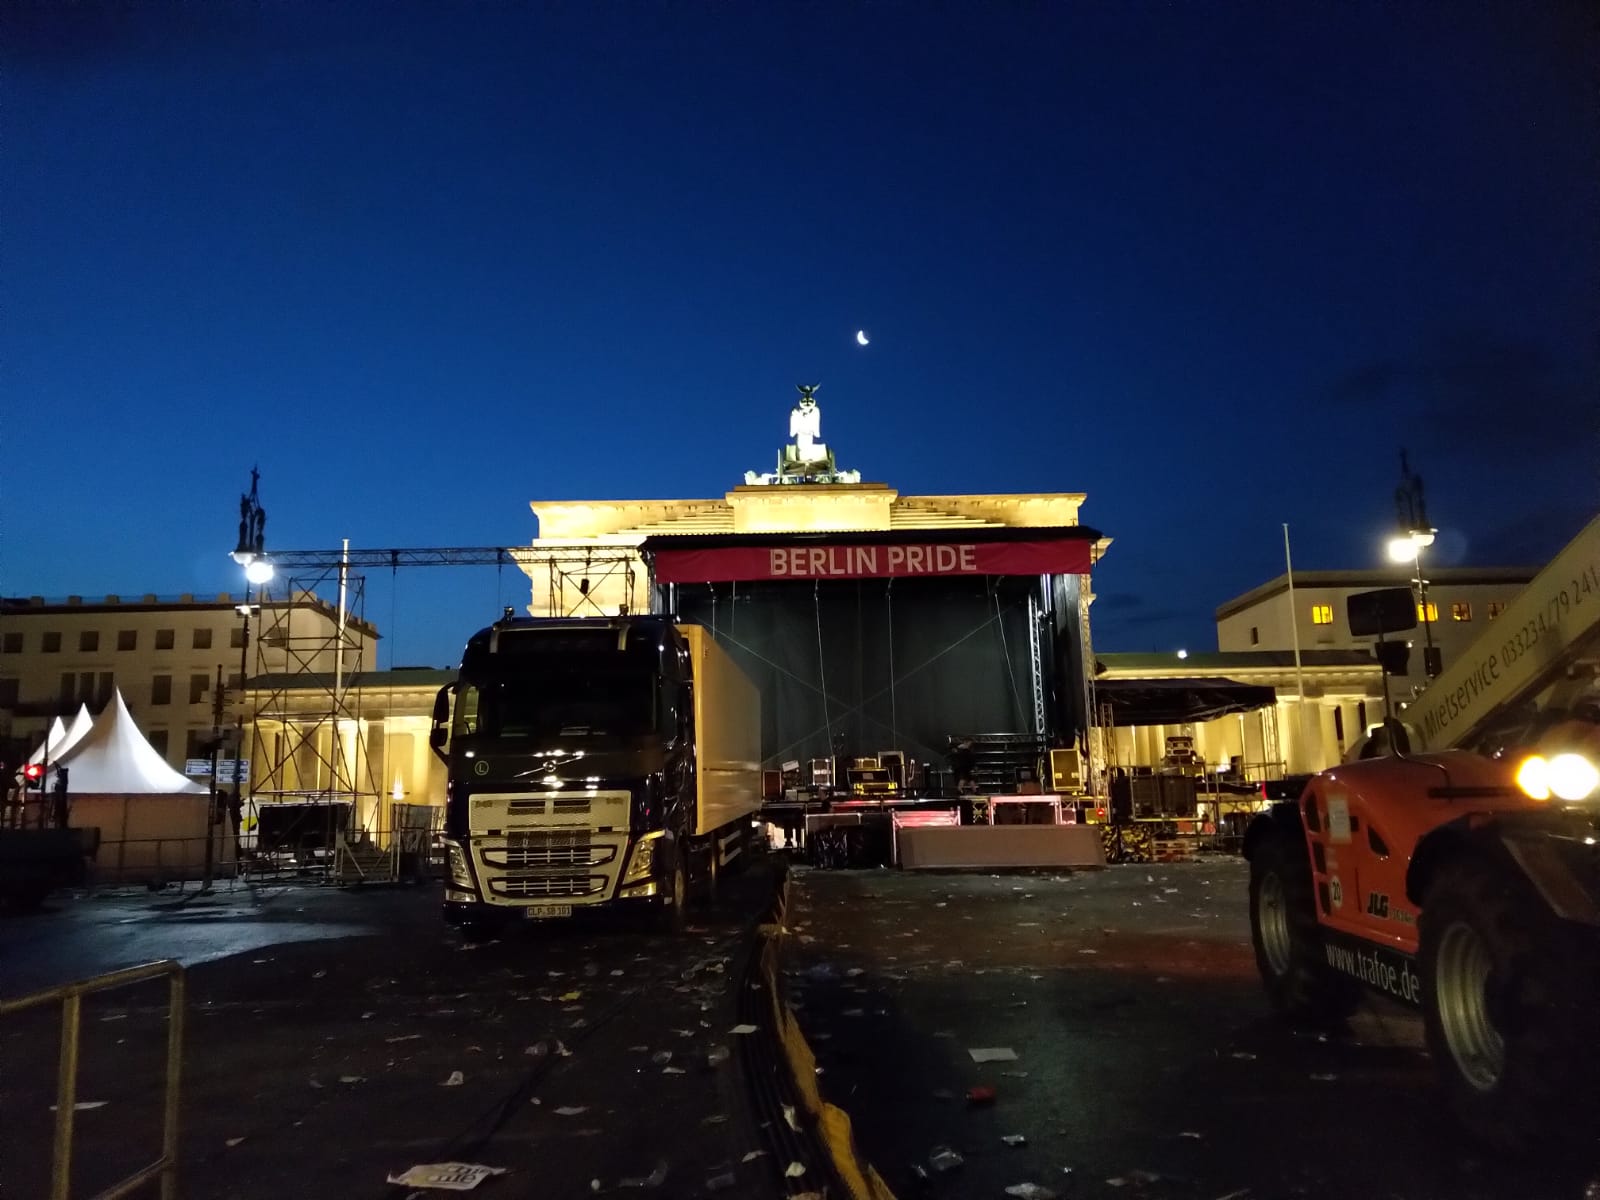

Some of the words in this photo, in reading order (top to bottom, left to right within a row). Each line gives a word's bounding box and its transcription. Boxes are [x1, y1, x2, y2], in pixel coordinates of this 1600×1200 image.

[770, 547, 877, 575] BERLIN
[888, 545, 977, 572] PRIDE
[1424, 655, 1499, 739] Mietservice
[1367, 892, 1389, 918] JLG
[1325, 943, 1420, 1004] www.trafoe.de
